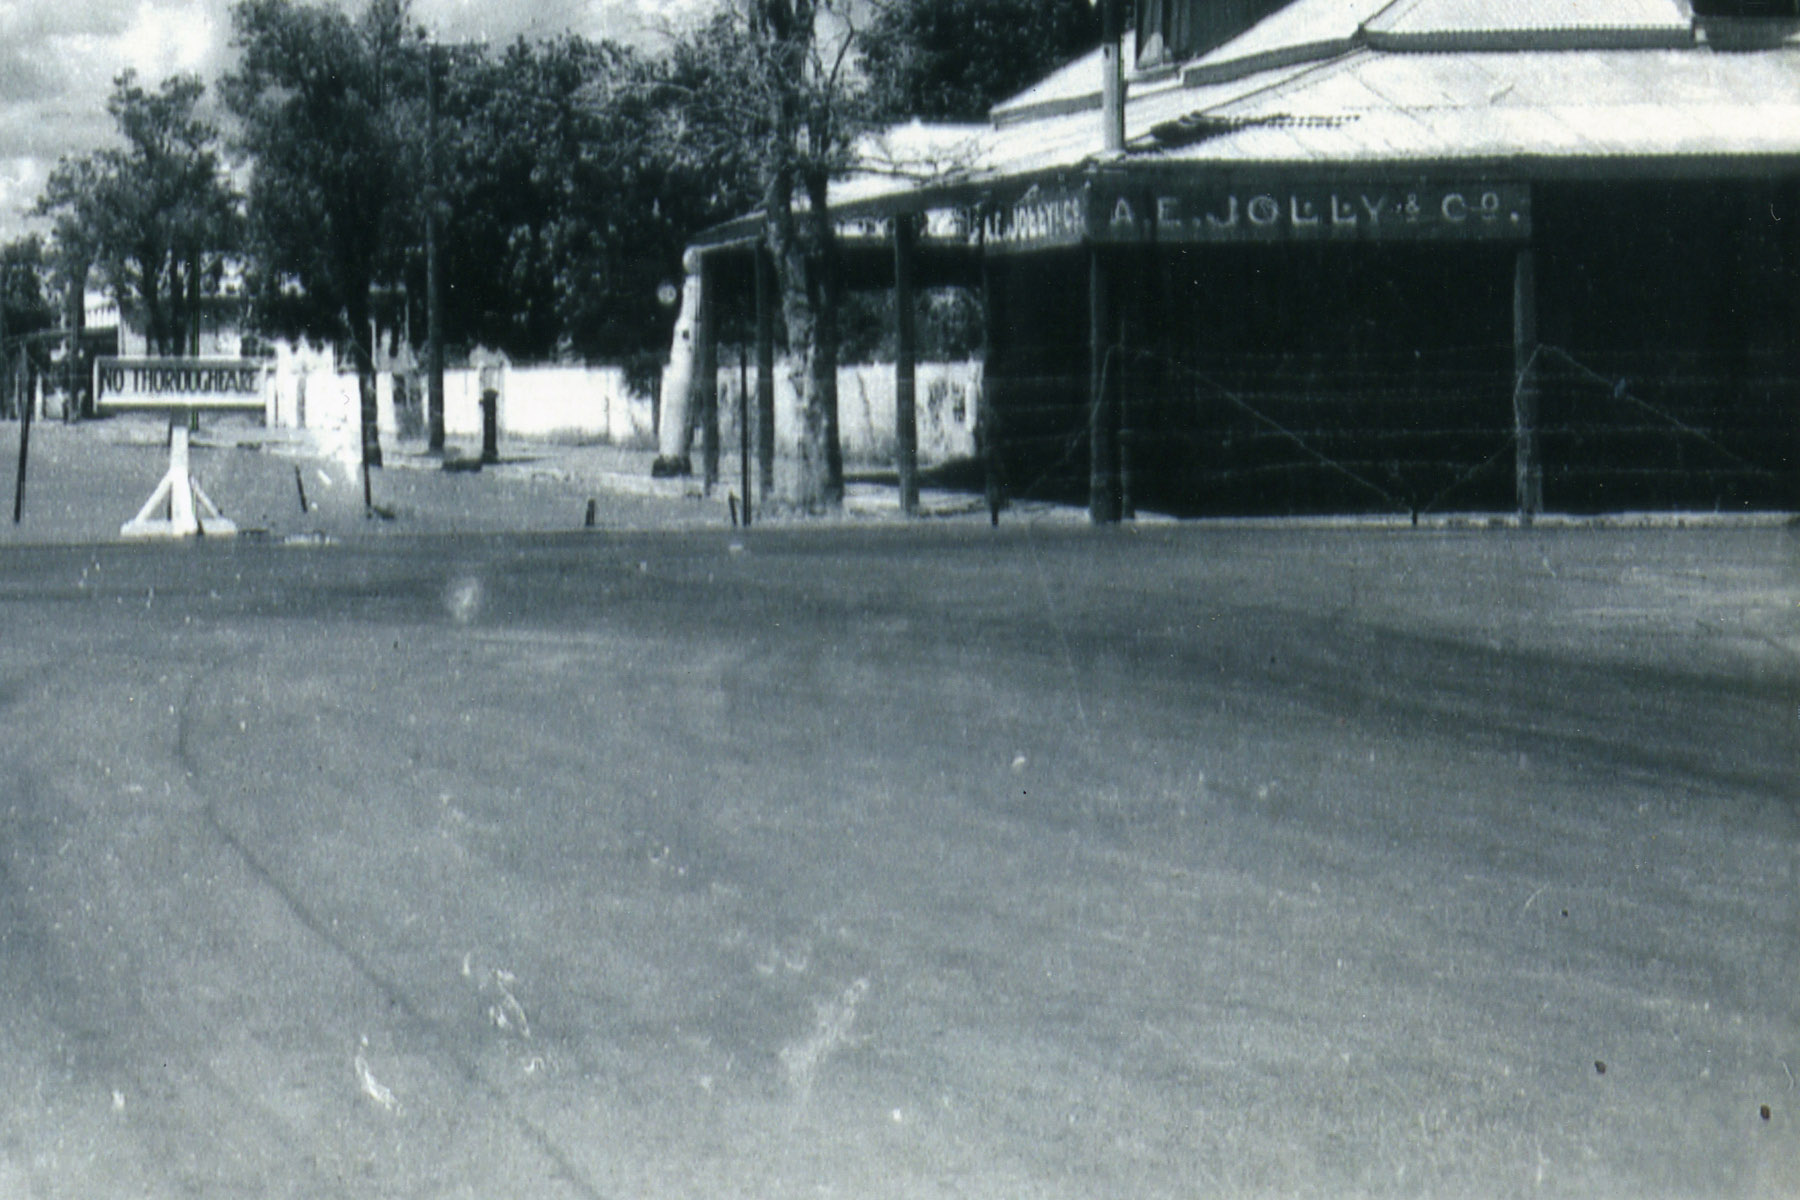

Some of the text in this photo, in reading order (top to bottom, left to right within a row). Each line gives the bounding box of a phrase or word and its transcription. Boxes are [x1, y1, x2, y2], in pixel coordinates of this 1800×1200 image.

[1205, 194, 1384, 226] JOLLY
[101, 367, 262, 394] NO THOROUGHFARE
